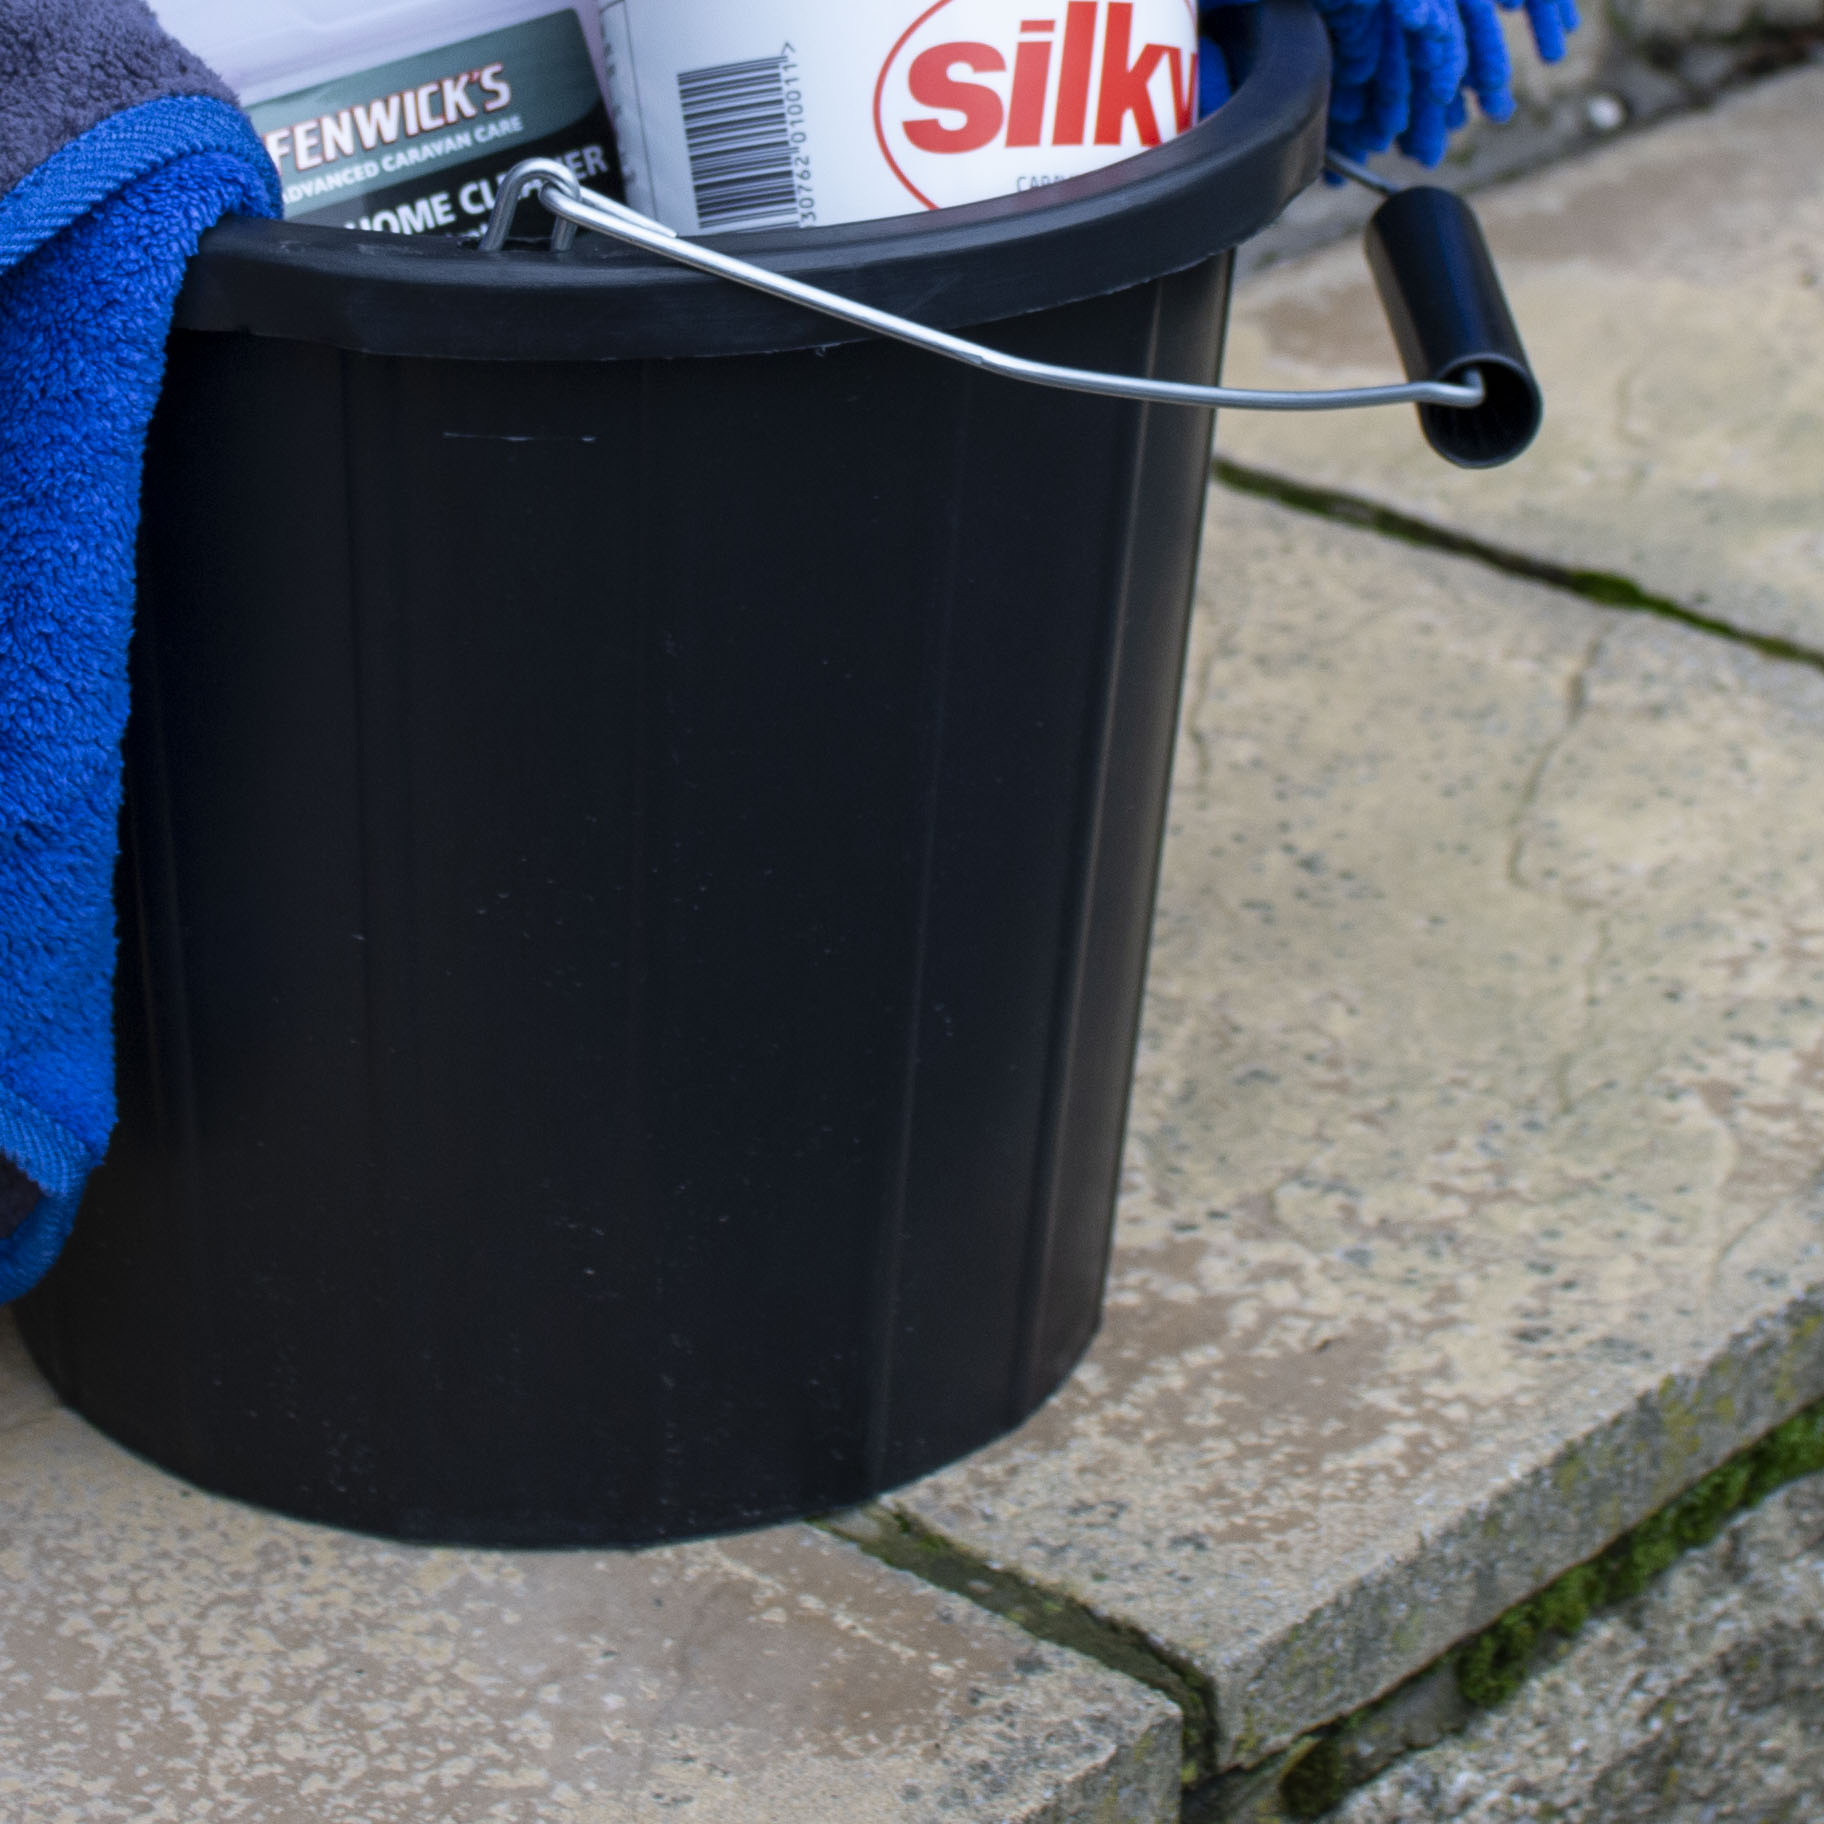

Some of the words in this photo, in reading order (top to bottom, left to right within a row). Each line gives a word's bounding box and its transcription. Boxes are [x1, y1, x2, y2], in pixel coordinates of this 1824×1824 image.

[263, 63, 512, 176] FENWICK'S
[381, 132, 472, 173] CARAVAN
[475, 116, 524, 143] CARE
